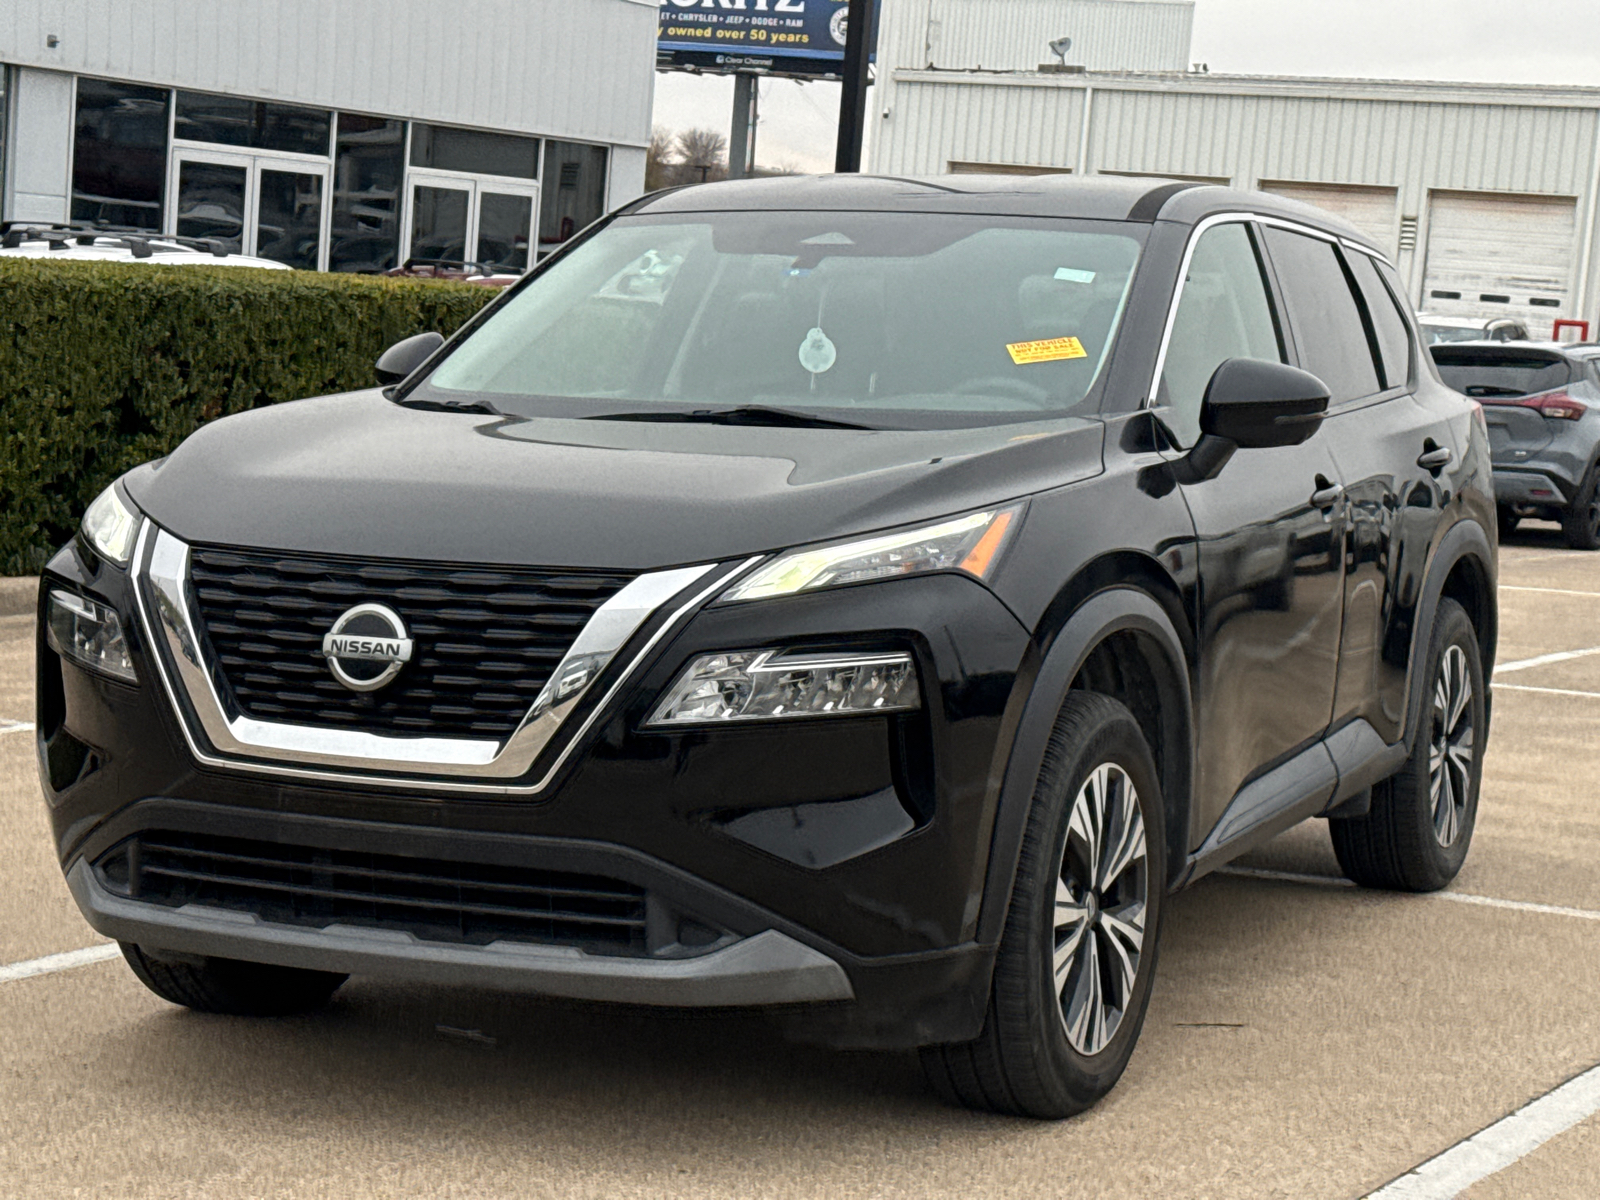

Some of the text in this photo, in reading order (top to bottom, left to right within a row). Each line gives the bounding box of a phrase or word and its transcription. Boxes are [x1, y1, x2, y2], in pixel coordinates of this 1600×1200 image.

[678, 12, 718, 23] CHRYSLER
[725, 15, 744, 24] JEEP
[751, 17, 778, 26] DODGE
[785, 18, 803, 27] RAM
[667, 27, 712, 37] owned
[716, 29, 746, 39] over
[749, 29, 767, 41] 50
[770, 32, 809, 44] years
[1034, 338, 1075, 347] VEHICLE
[331, 639, 400, 656] NISSAN
